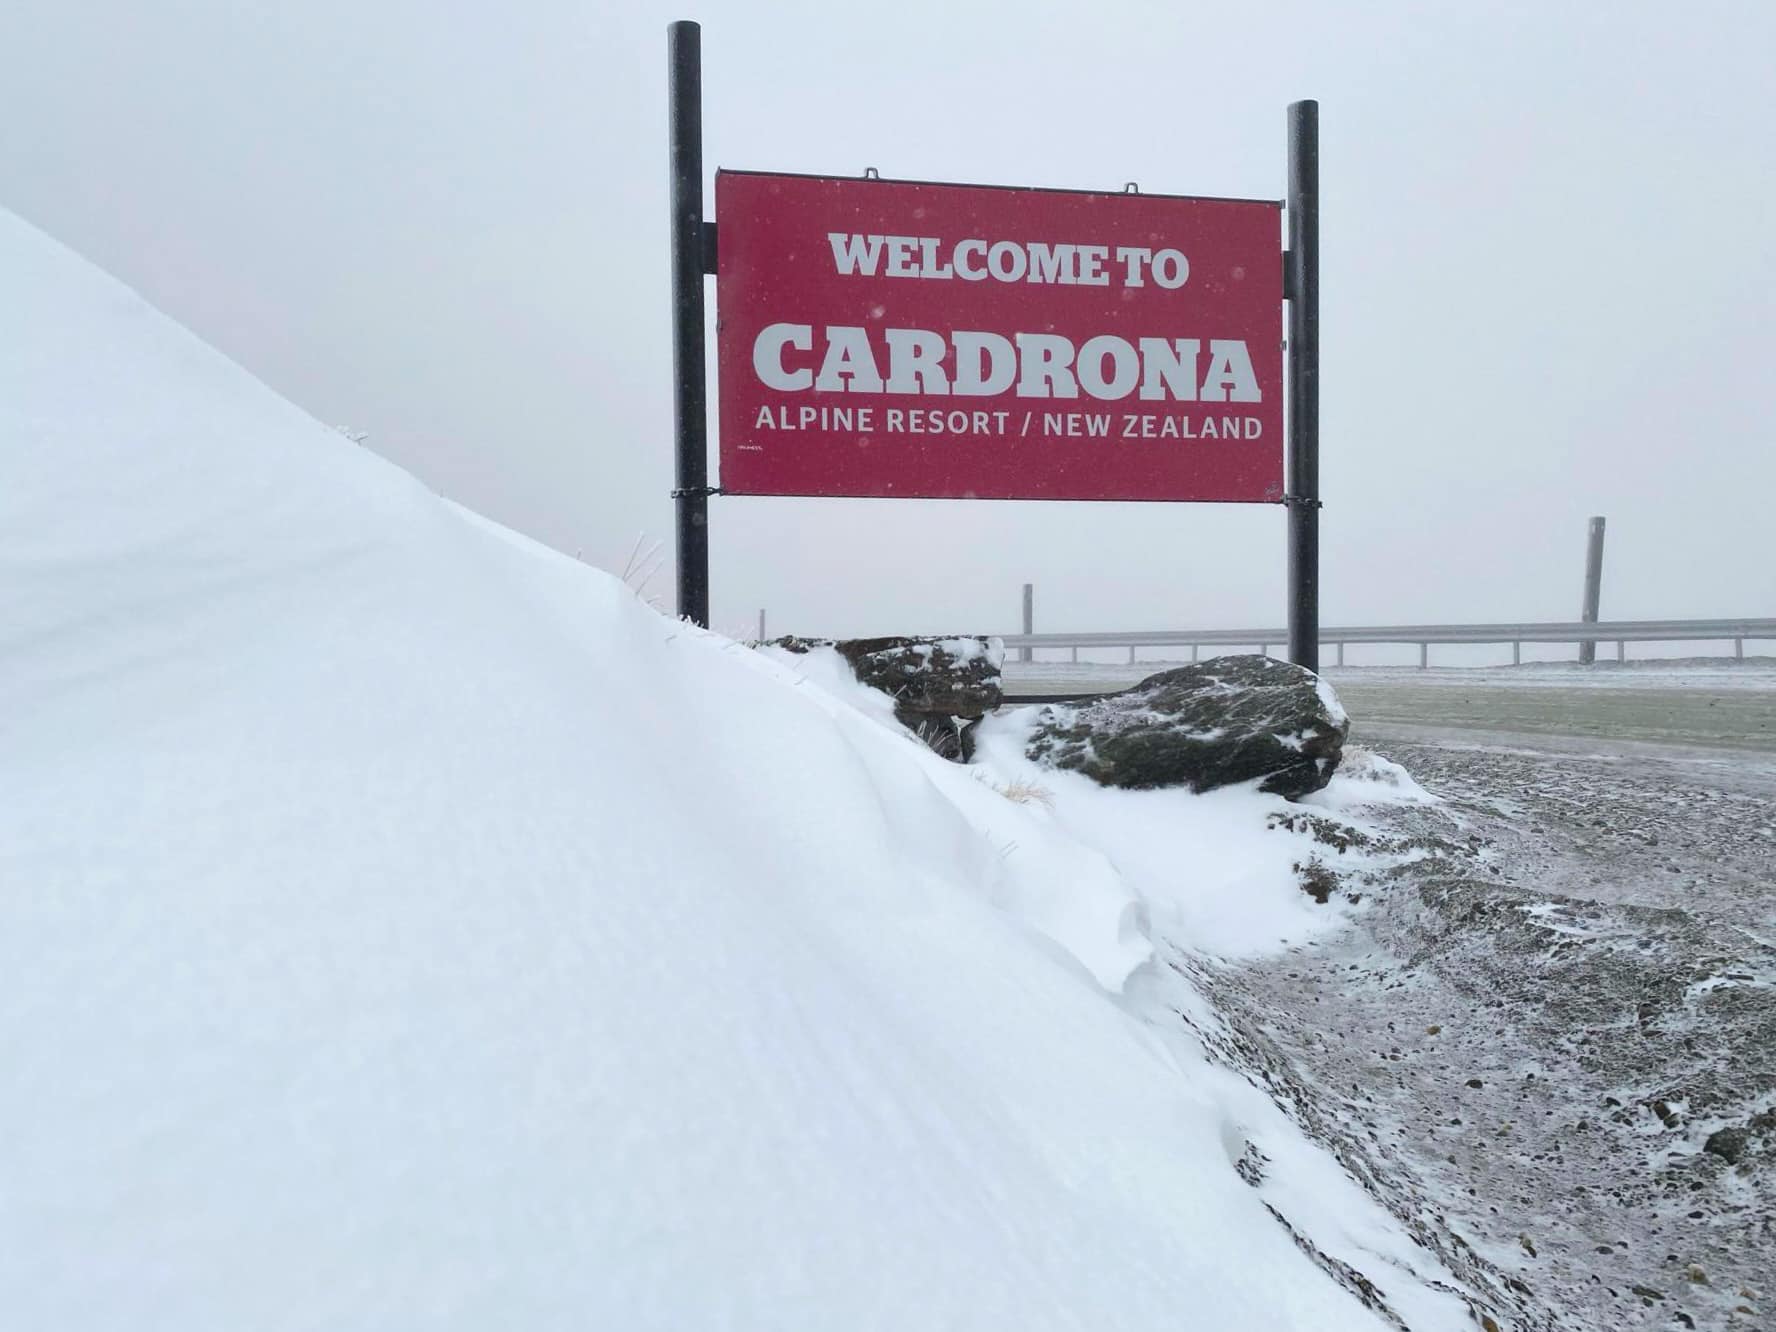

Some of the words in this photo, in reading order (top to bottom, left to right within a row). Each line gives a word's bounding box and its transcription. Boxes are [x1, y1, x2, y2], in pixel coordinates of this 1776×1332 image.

[827, 232, 1110, 287] WELCOME
[1116, 246, 1190, 289] TO
[752, 322, 1262, 404] CARDRONA
[755, 405, 874, 432] ALPINE
[887, 409, 1010, 435] RESORT
[1021, 411, 1032, 437] /
[1044, 413, 1111, 437] NEW
[1122, 414, 1262, 440] ZEALAND
